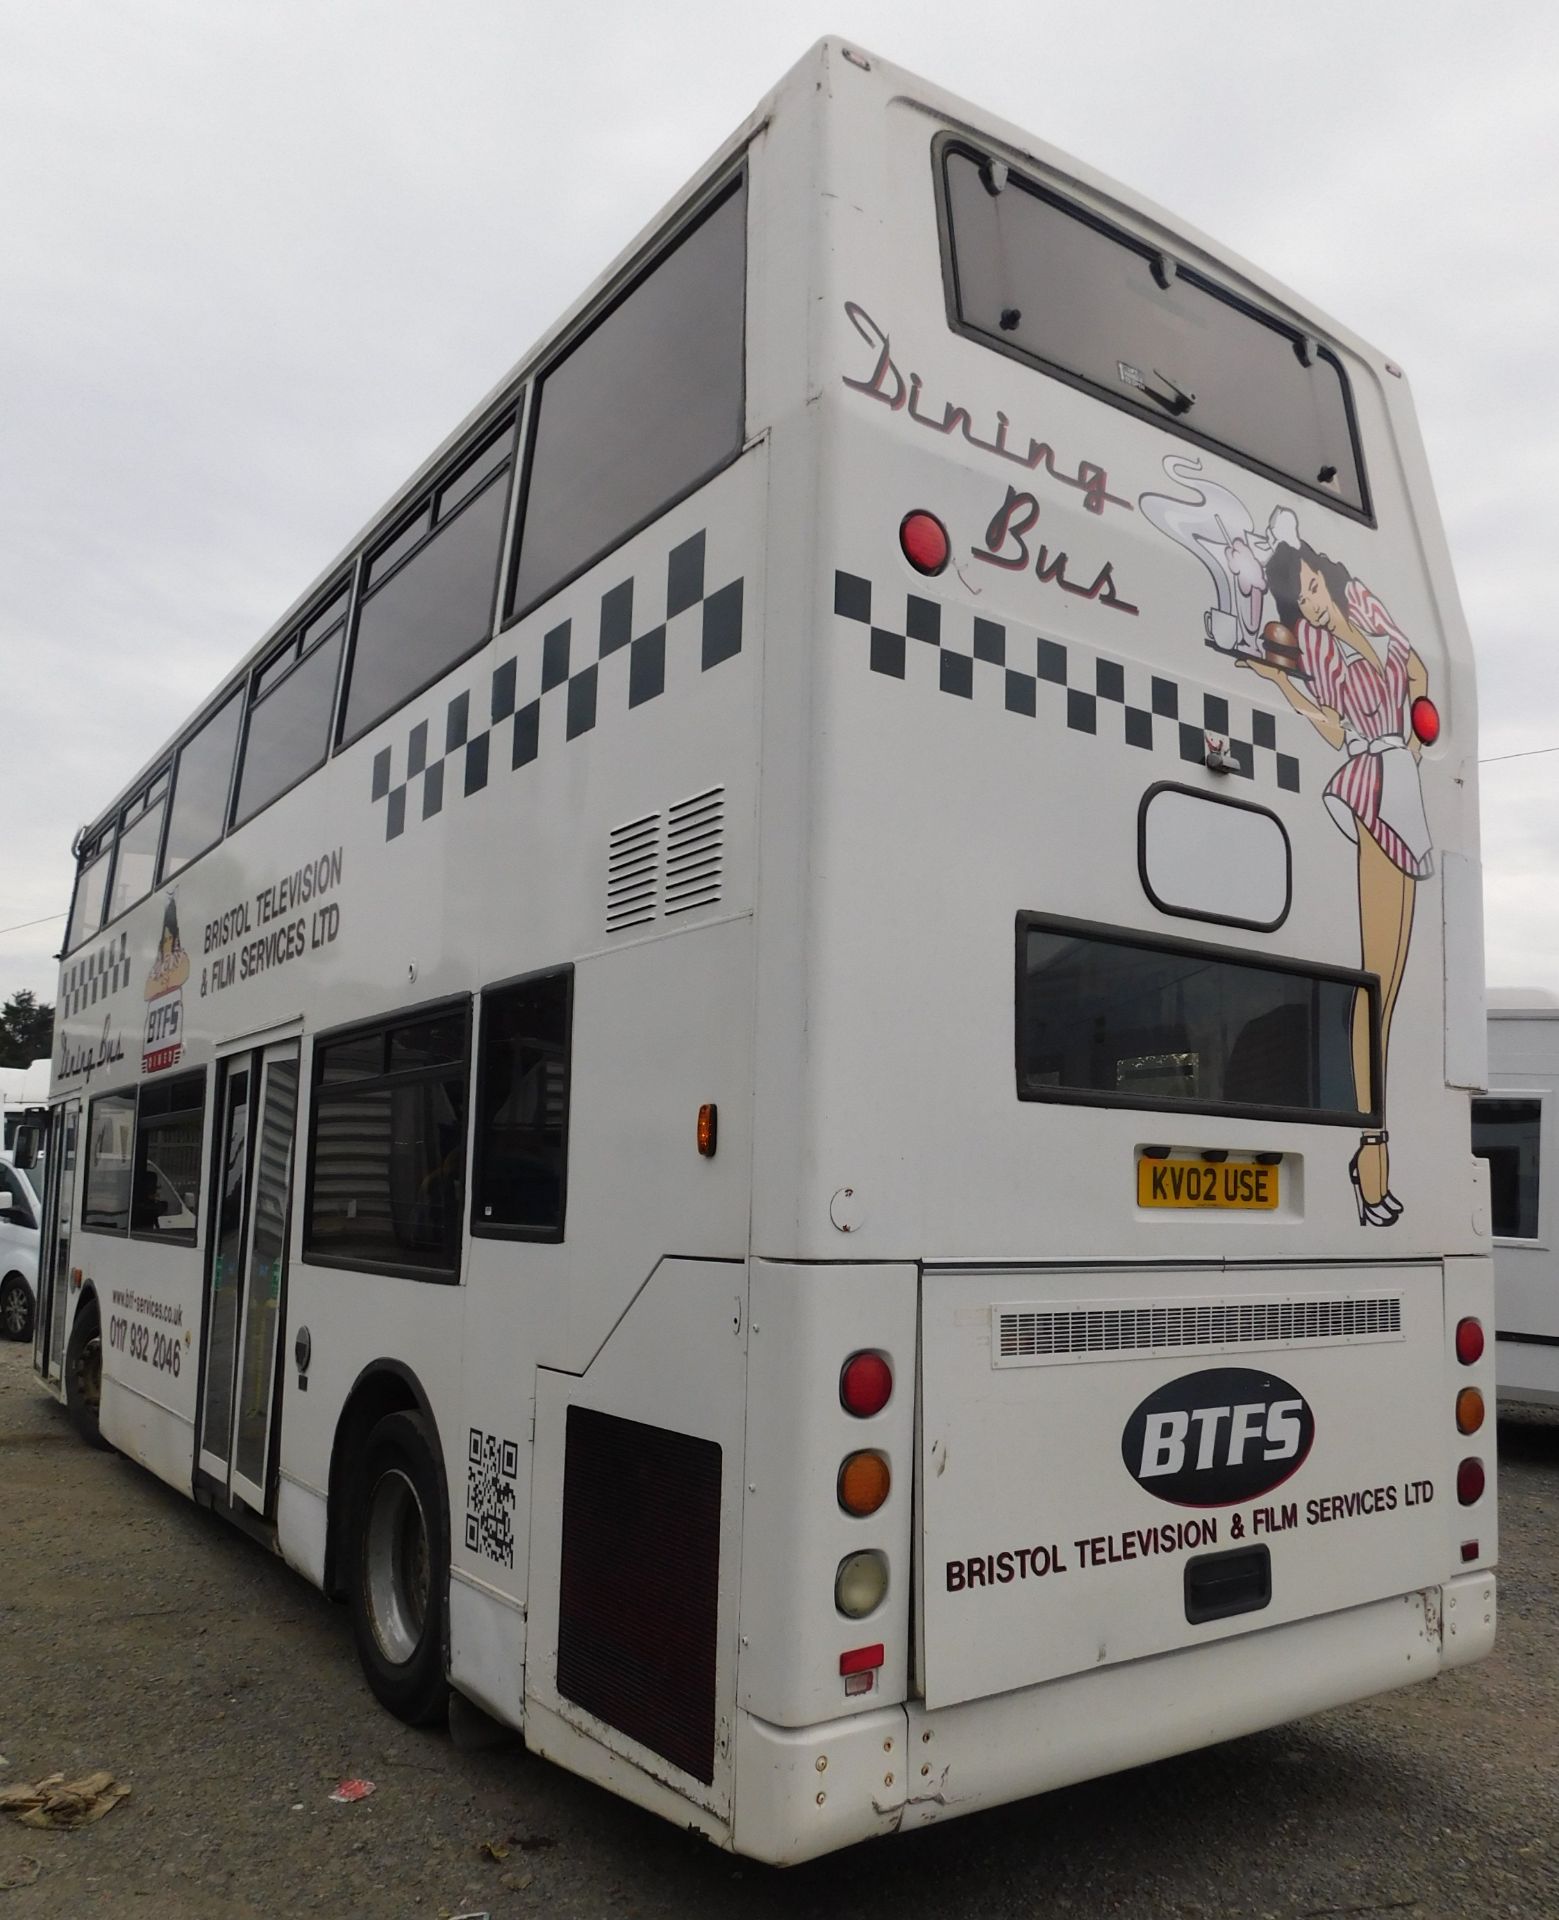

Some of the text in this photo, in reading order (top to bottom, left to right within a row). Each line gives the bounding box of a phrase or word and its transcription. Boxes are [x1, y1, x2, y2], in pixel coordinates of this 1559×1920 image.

[842, 301, 1134, 515] Dining
[971, 485, 1139, 616] Bus
[204, 846, 343, 954] BRISTOL TELEVISION
[201, 902, 340, 998] & FILM SERVICES LTD
[58, 1013, 124, 1084] Dining Bus
[147, 1000, 180, 1043] BTFS
[1152, 1166, 1268, 1202] KV02 USE
[110, 1315, 181, 1378] 0117 932 2046
[1138, 1399, 1303, 1479] BTFS
[946, 1480, 1434, 1592] BRISTOL TELEVISION & FILM SERVICES LTD
